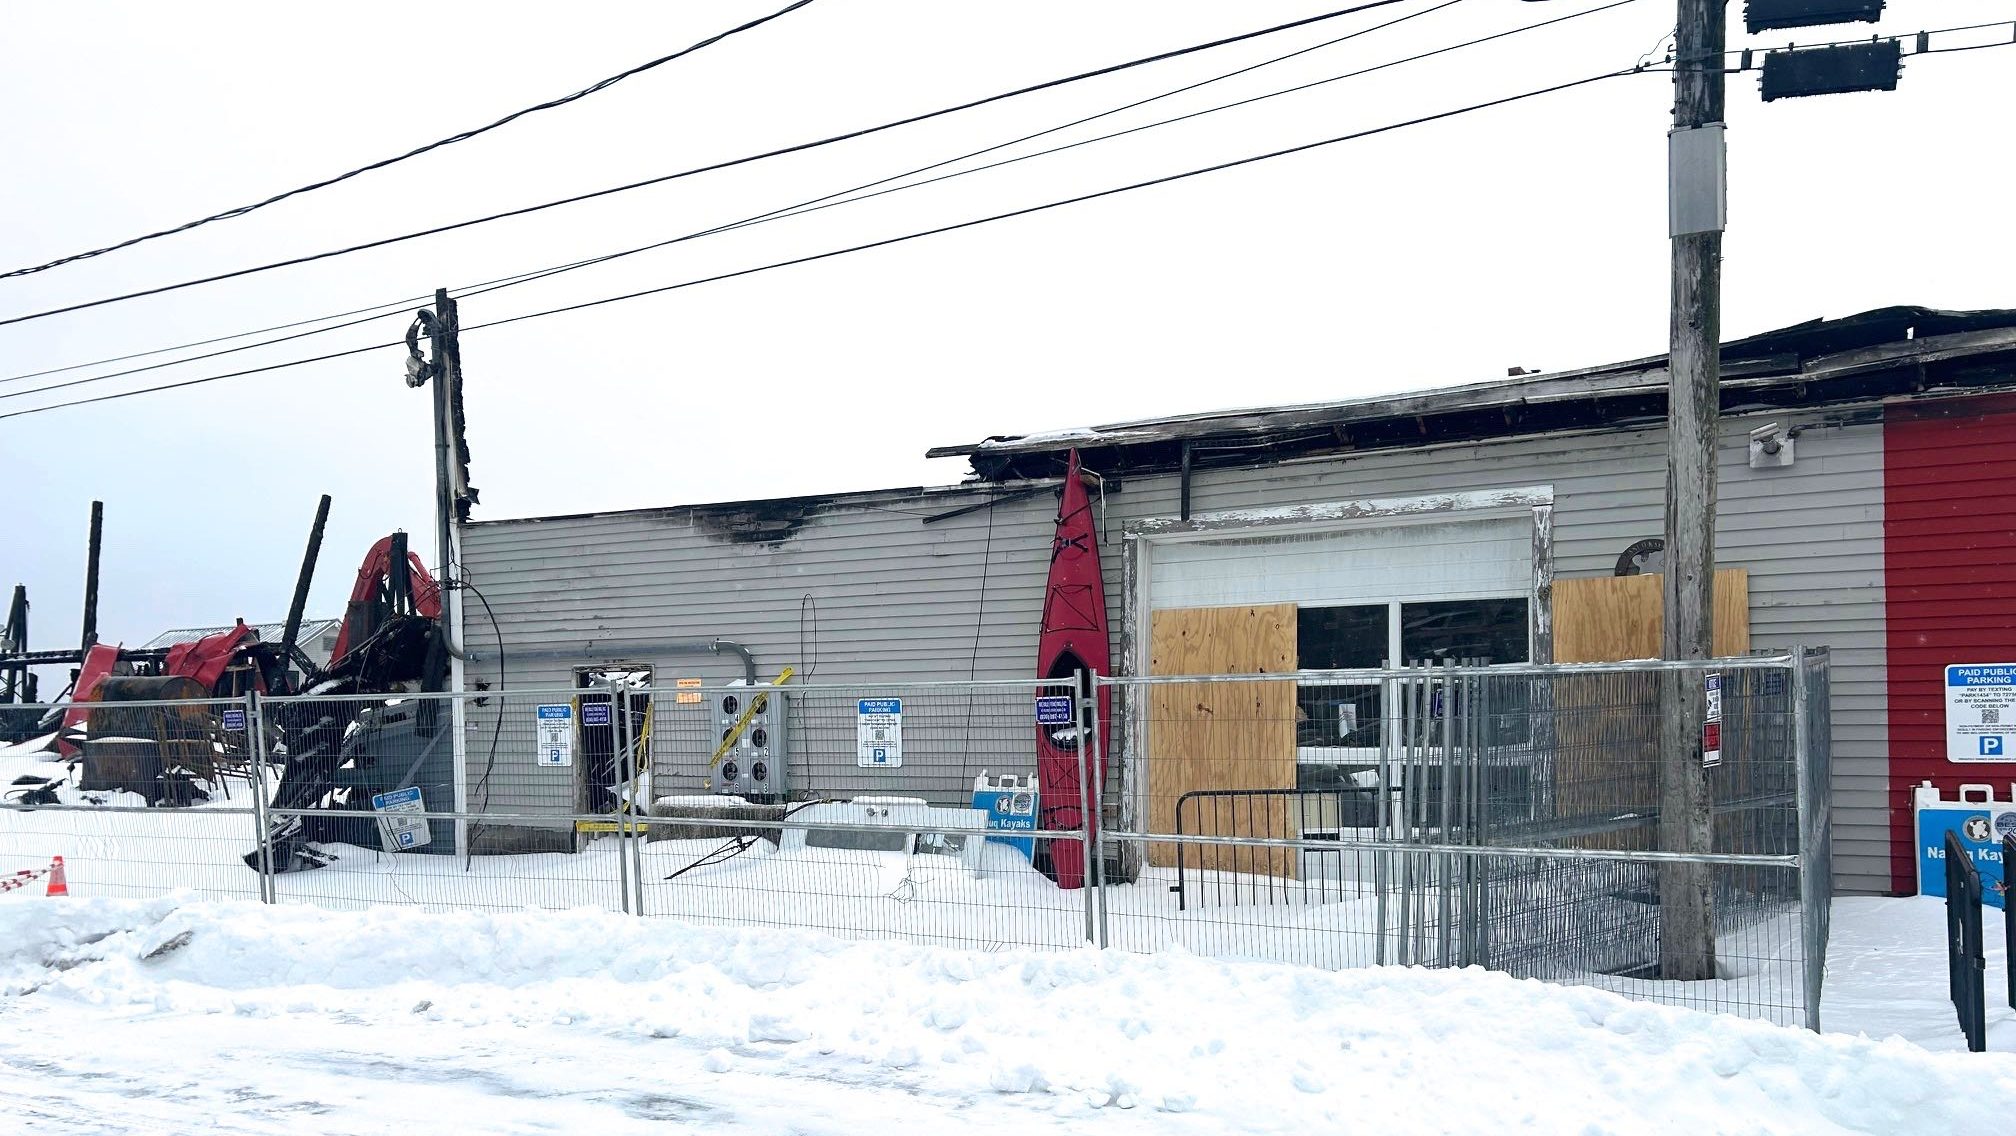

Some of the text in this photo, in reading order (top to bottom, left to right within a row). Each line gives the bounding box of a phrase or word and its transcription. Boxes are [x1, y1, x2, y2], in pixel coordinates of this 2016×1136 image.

[1967, 676, 2011, 684] PARKING
[1984, 738, 1999, 754] P
[552, 751, 558, 760] P
[876, 750, 884, 762] P
[1000, 818, 1030, 830] Kayaks
[402, 834, 410, 844] P
[1927, 846, 2004, 864] Naq Kay
